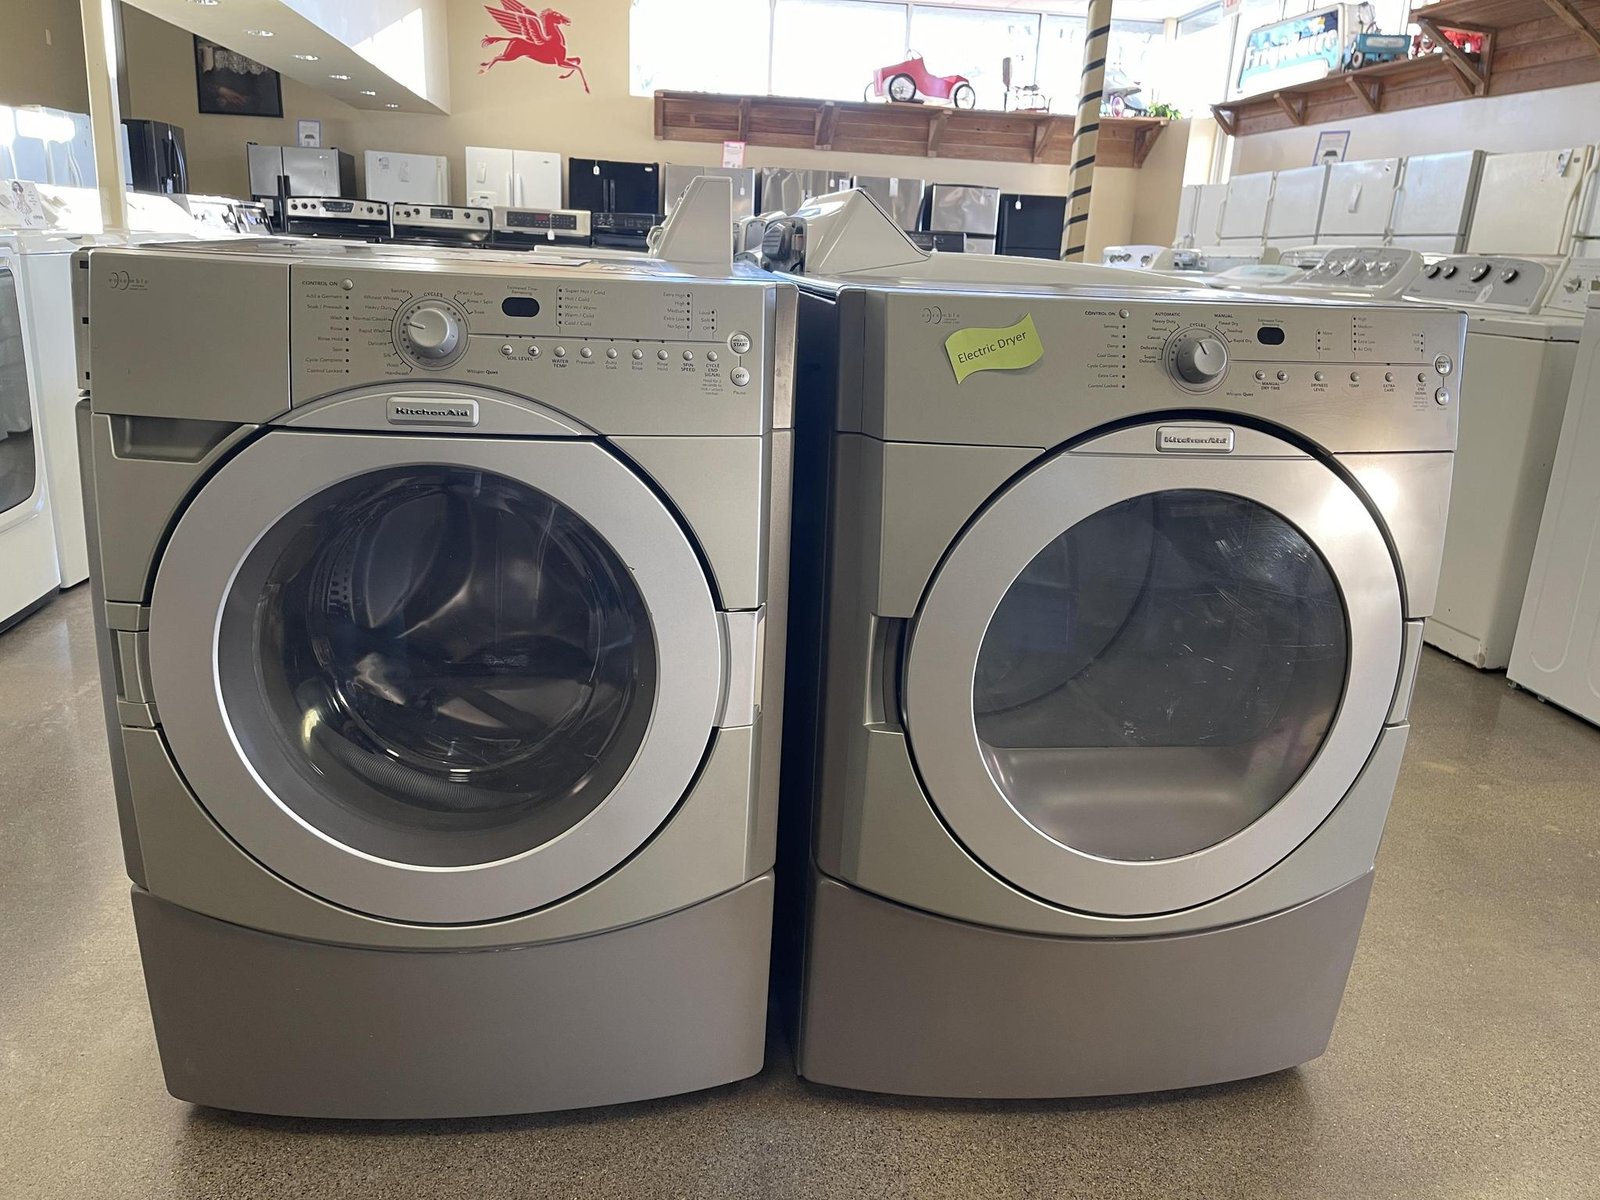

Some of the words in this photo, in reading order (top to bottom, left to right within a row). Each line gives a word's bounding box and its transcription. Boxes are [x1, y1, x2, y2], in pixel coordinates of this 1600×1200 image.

[957, 343, 996, 363] Electric
[997, 331, 1027, 350] Dryer
[396, 407, 469, 416] KitchenAid
